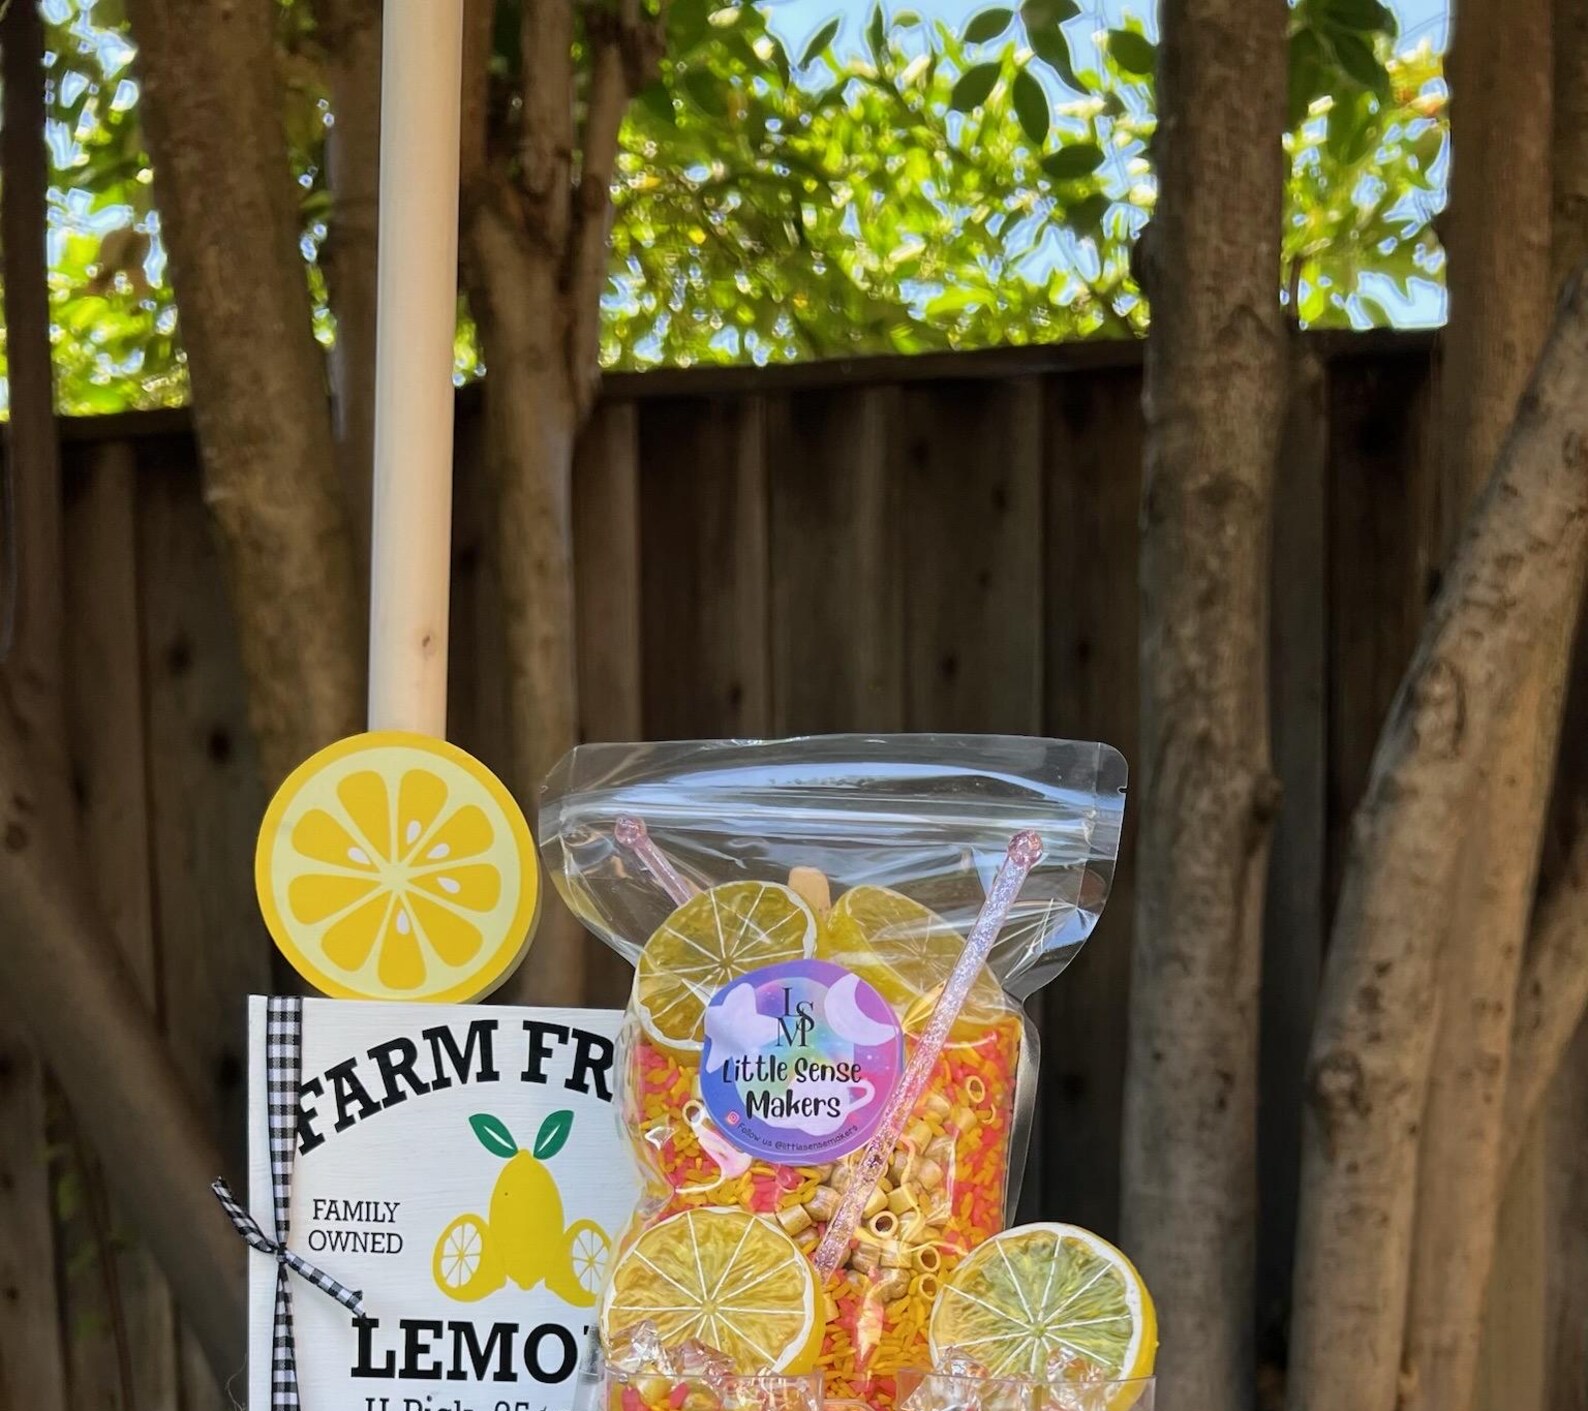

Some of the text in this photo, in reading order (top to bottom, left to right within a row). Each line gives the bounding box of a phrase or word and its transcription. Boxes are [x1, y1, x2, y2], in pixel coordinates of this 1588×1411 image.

[722, 1053, 862, 1084] Little Sense
[297, 1019, 501, 1156] FARM
[745, 1089, 841, 1120] Makers
[737, 1122, 760, 1142] Follow
[762, 1138, 773, 1147] us
[311, 1198, 401, 1224] FAMILY
[307, 1229, 404, 1255] OWNED
[350, 1317, 589, 1384] LEMO
